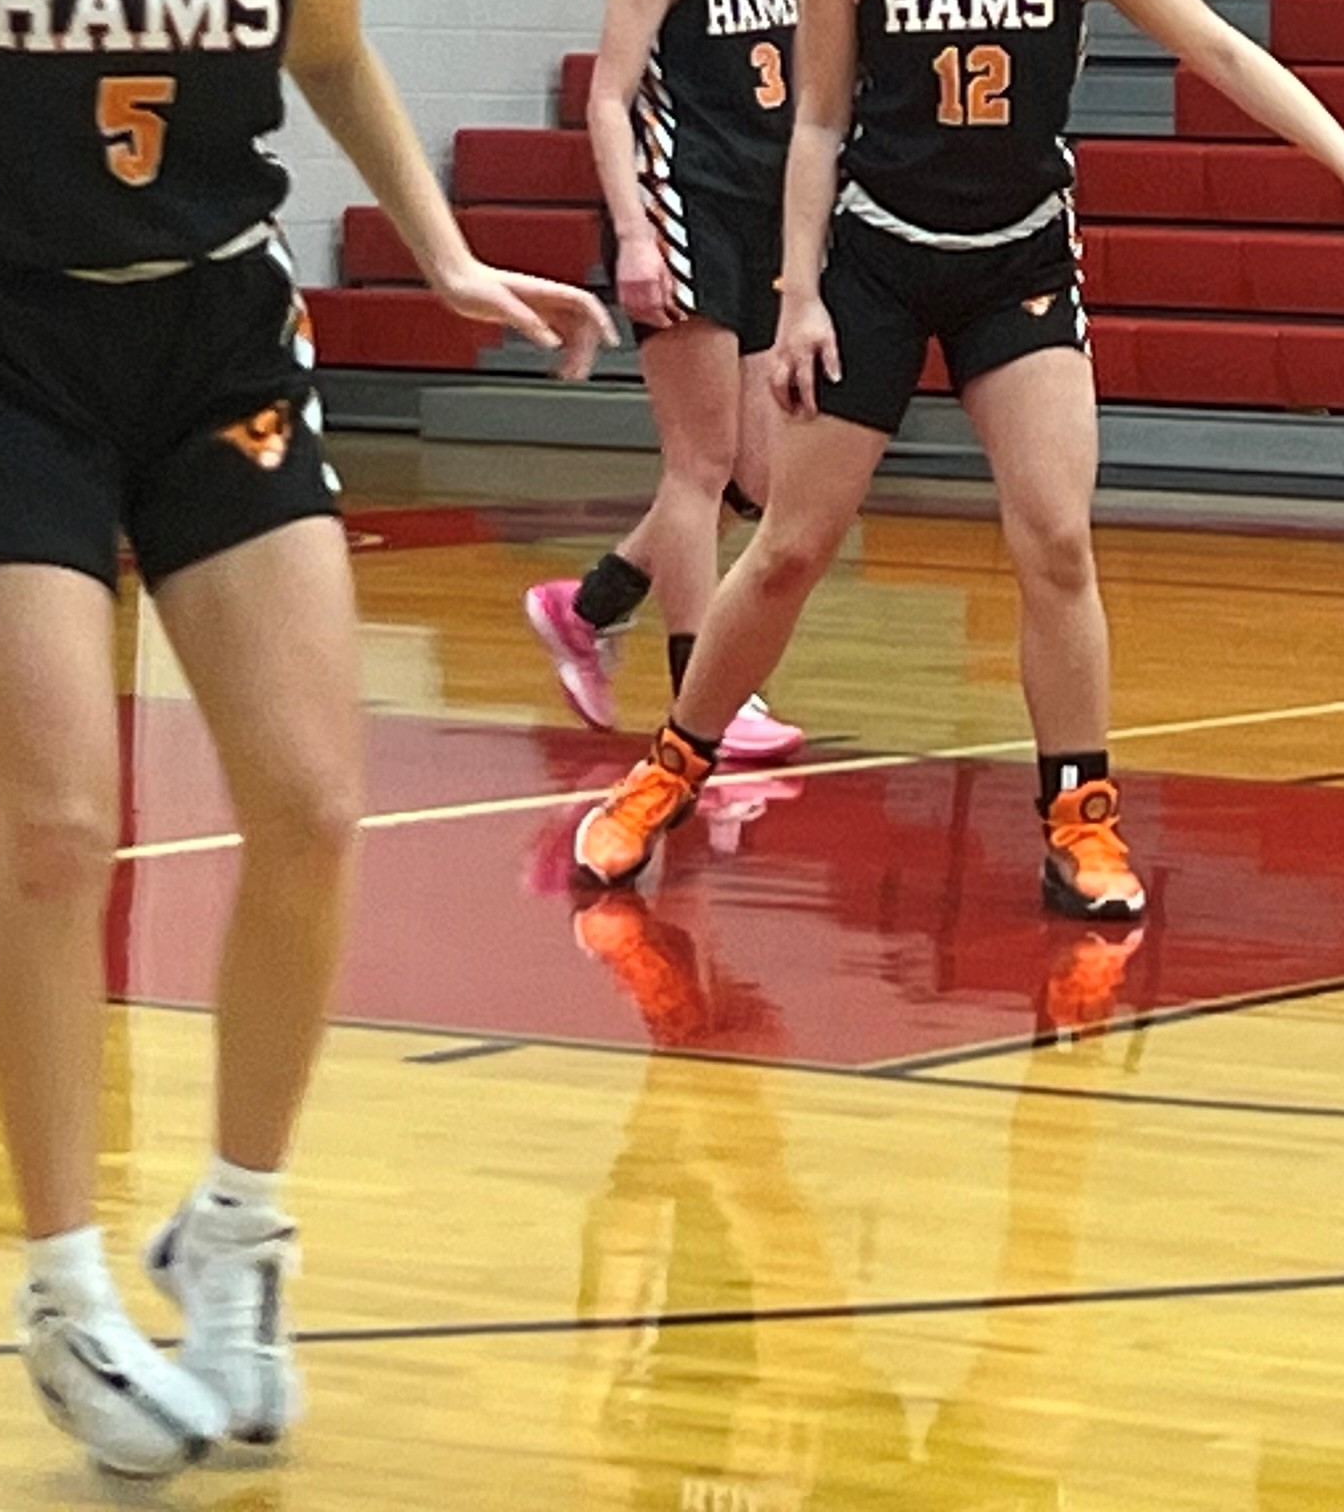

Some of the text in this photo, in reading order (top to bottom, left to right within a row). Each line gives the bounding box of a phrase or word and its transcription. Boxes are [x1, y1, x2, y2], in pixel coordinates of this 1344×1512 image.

[750, 41, 787, 110] 3
[933, 44, 1011, 126] 12
[95, 75, 177, 186] 5
